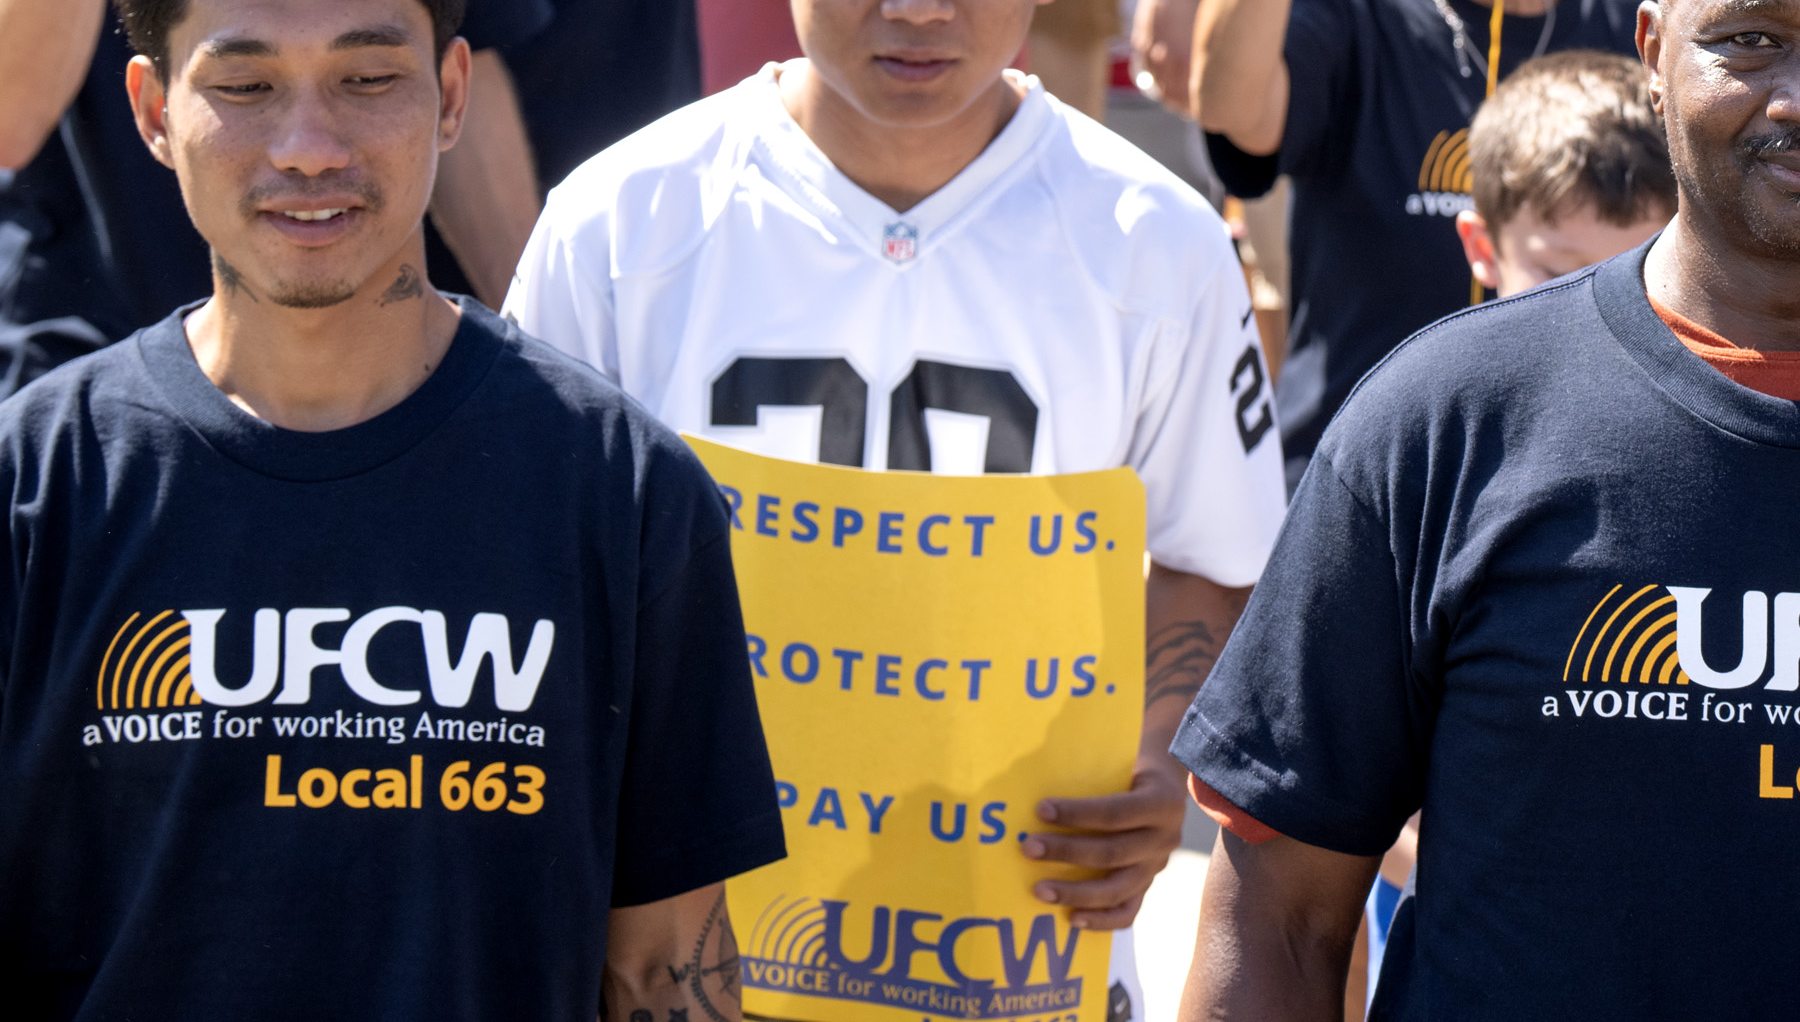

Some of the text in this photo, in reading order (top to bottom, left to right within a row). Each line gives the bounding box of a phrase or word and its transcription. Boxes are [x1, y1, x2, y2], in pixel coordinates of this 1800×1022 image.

[719, 484, 1116, 557] RESPECT US.
[180, 606, 555, 712] UFCW
[746, 634, 1116, 701] ROTECT US.
[82, 710, 546, 747] a VOICE for working America
[1541, 695, 1559, 717] a
[1565, 689, 1688, 720] VOICE
[1701, 693, 1752, 724] for
[264, 755, 547, 815] Local 663
[776, 780, 1029, 844] PAY US.
[820, 899, 1081, 989] UFCW
[749, 961, 830, 993] VOICE
[838, 974, 874, 998] for
[882, 984, 982, 1019] working
[991, 985, 1078, 1017] America
